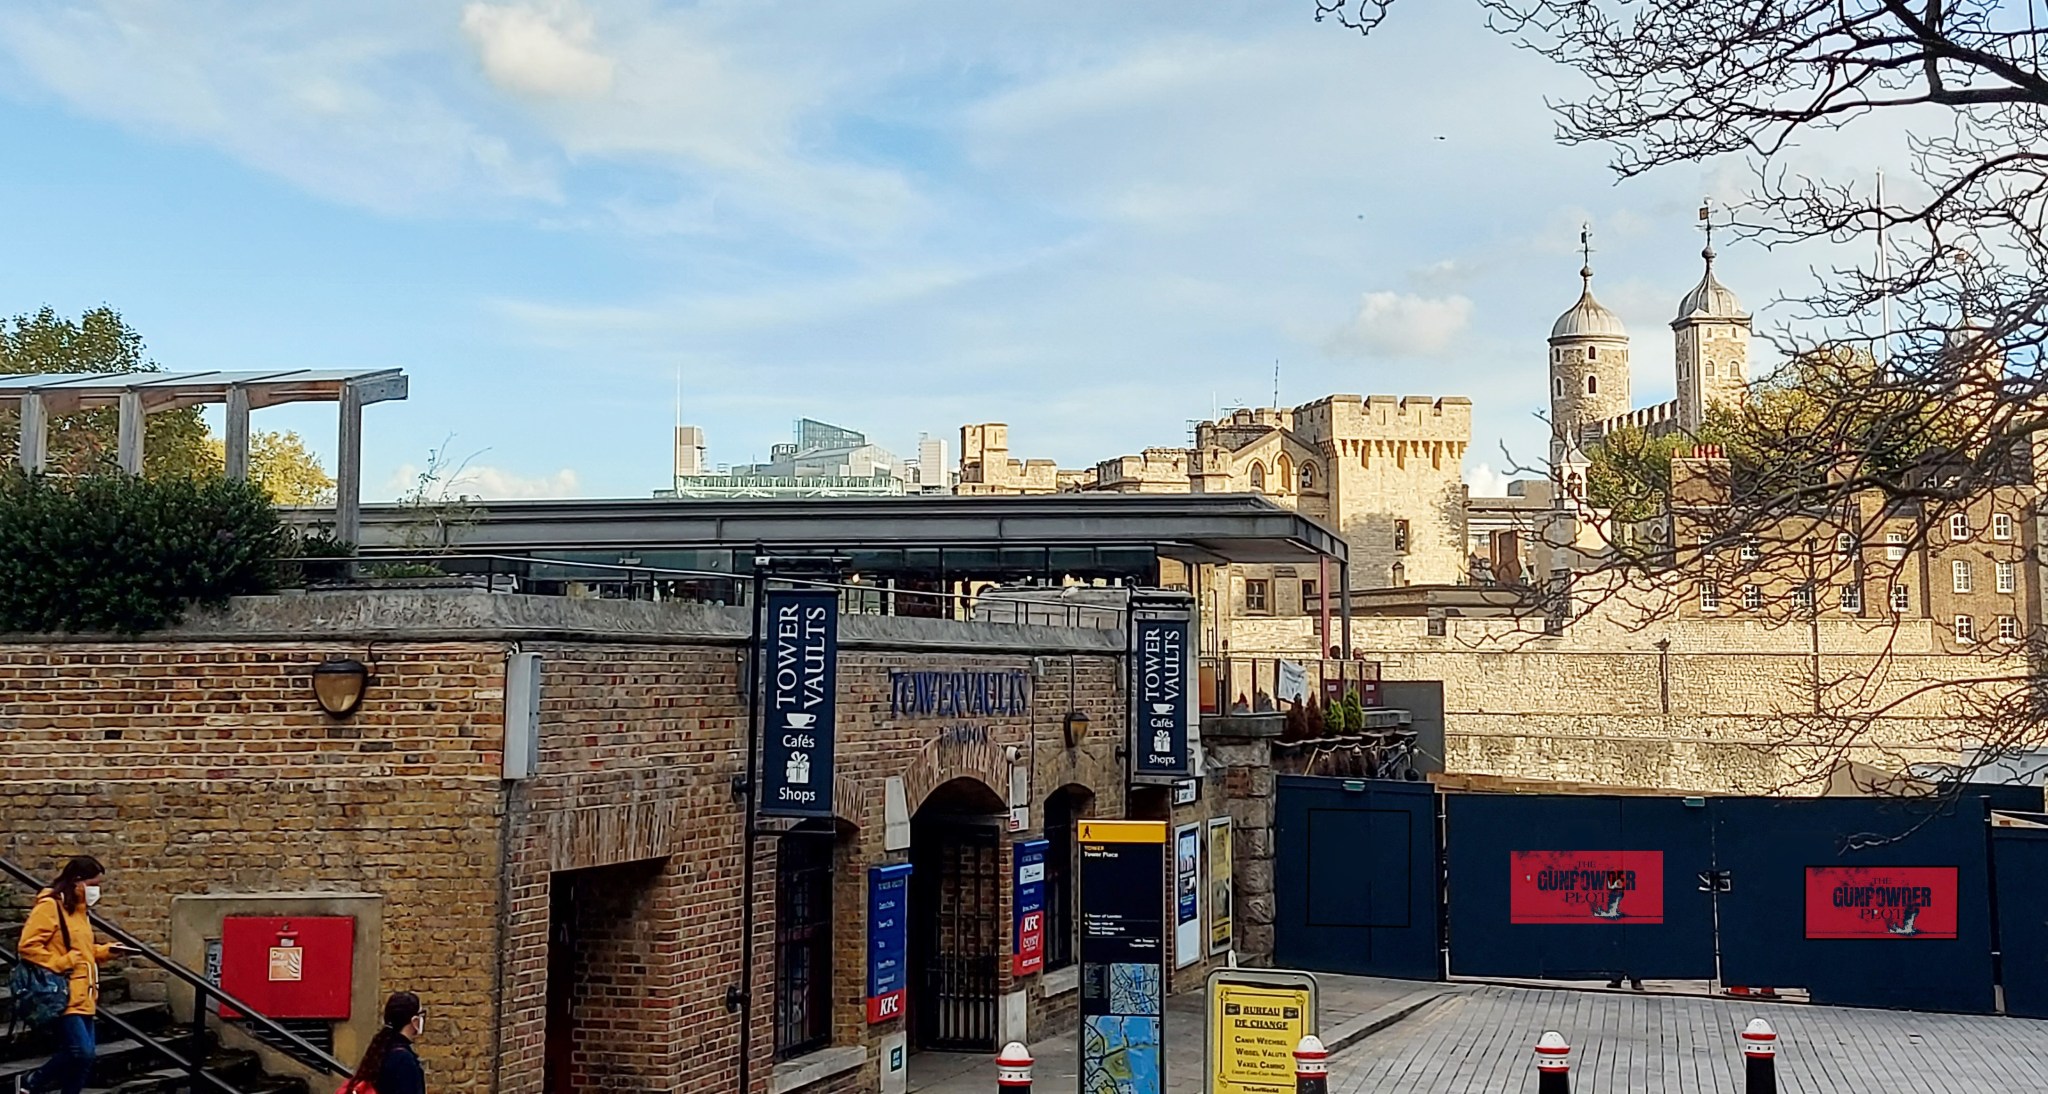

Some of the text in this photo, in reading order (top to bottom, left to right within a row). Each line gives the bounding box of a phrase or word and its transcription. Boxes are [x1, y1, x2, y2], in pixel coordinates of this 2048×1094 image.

[777, 604, 799, 709] TOWER
[804, 607, 826, 709] VAULTS
[1145, 628, 1160, 702] TOWER
[1165, 630, 1180, 701] VAULTS
[783, 734, 815, 748] Cafés
[1149, 754, 1176, 767] Shops
[779, 787, 816, 804] Shops
[1578, 860, 1596, 868] THE
[1537, 870, 1636, 891] GUNPOWDER
[1872, 877, 1892, 885] THE
[1833, 886, 1932, 907] GUNPOWDER
[1023, 915, 1040, 932] KFC
[880, 995, 899, 1016] KFC
[1243, 1006, 1280, 1016] BUREAU
[1235, 1019, 1288, 1030] DE CHANGE
